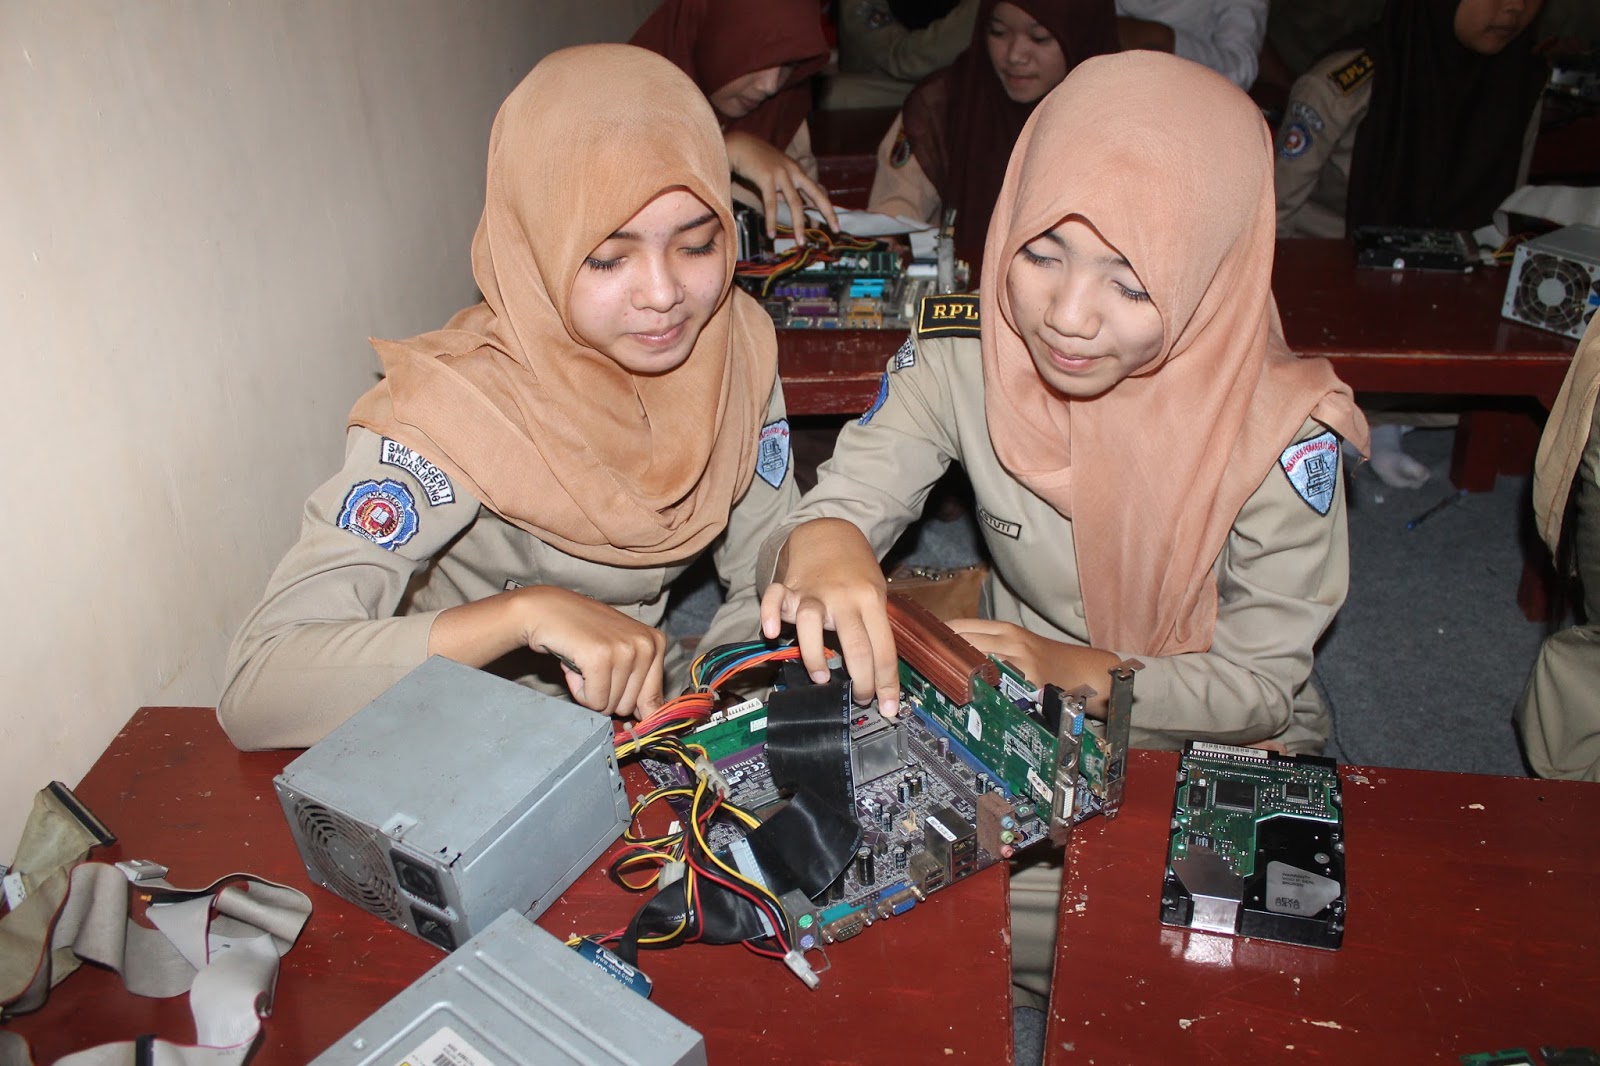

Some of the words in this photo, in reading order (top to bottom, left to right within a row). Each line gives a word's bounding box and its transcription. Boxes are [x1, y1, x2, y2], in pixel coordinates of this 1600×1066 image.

[932, 304, 979, 320] RPL
[387, 452, 441, 503] WADASLINTANG
[388, 442, 413, 459] SMK
[416, 455, 449, 492] NEGERI
[981, 511, 1010, 532] STUTI
[1282, 872, 1311, 880] WARRANTY
[595, 954, 634, 984] www.asus.com
[596, 947, 635, 978] ASUS
